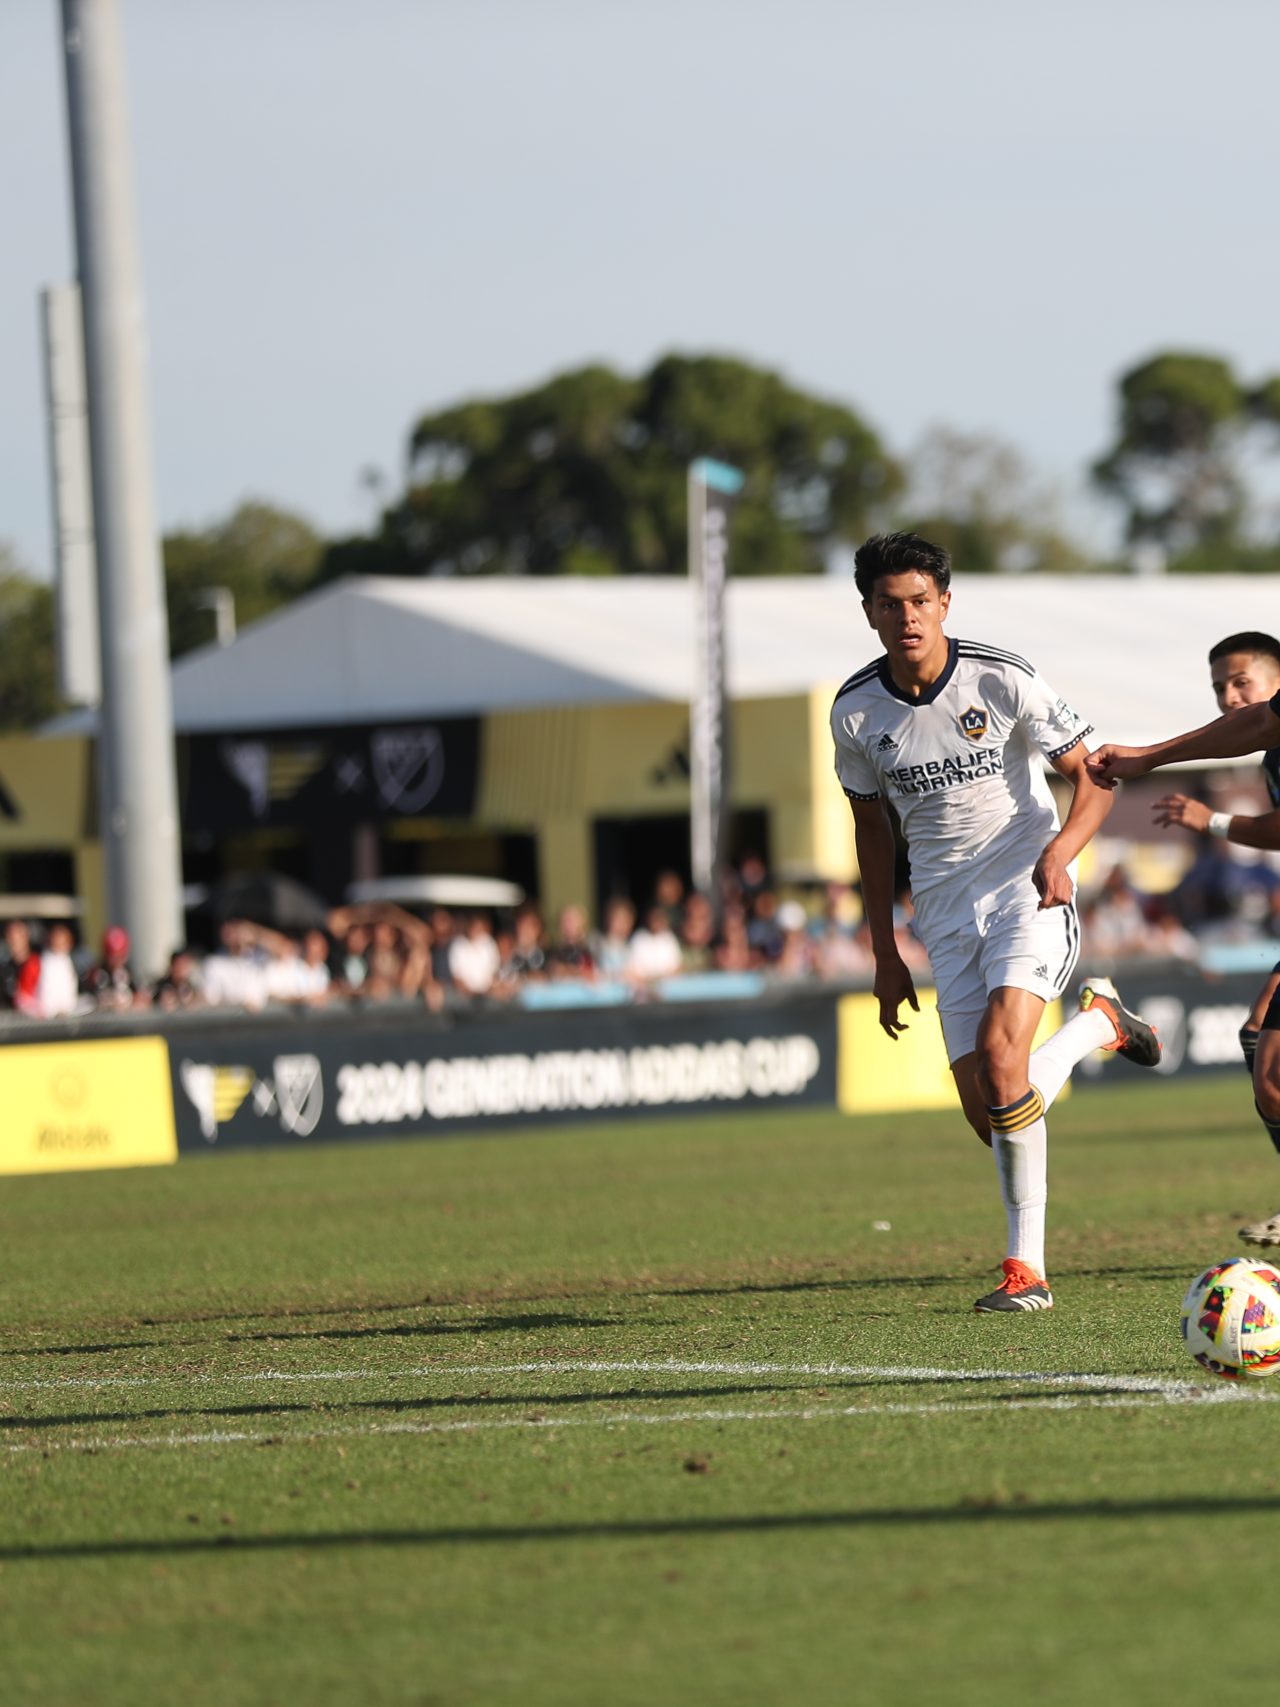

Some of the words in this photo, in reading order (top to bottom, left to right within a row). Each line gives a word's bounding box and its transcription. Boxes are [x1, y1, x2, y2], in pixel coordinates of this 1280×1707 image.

[965, 716, 984, 730] LA
[884, 748, 1001, 783] HERBALIFE
[337, 1064, 423, 1124] 2024
[424, 1049, 626, 1119] GENERATION
[628, 1038, 746, 1104] ADIDAS
[745, 1035, 820, 1097] CUP
